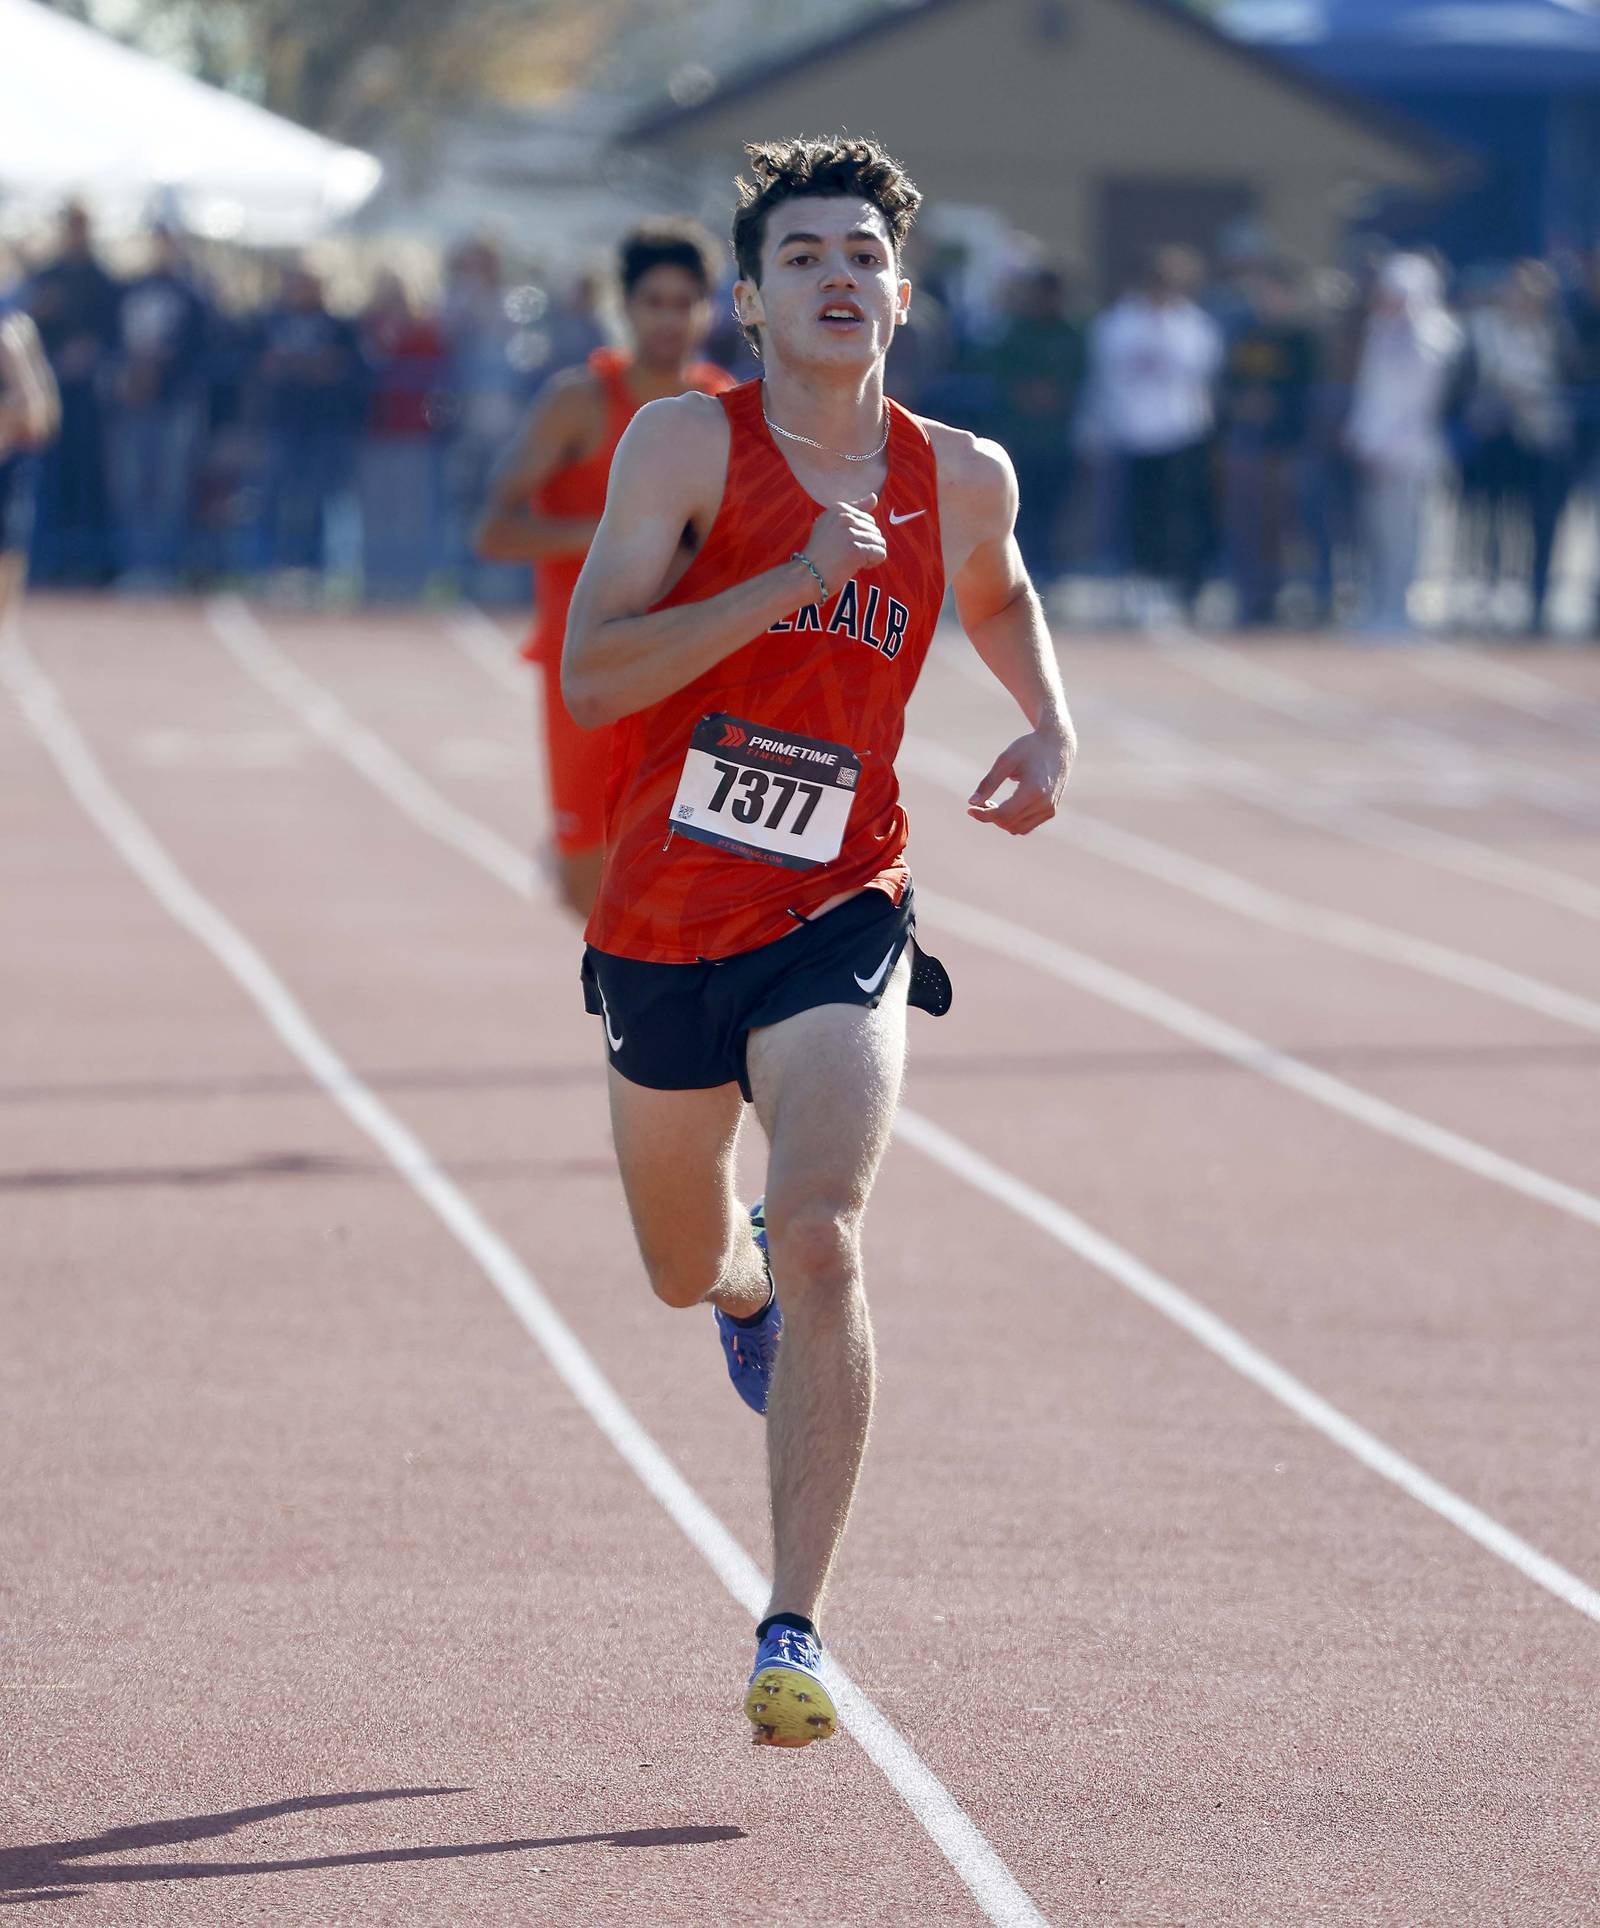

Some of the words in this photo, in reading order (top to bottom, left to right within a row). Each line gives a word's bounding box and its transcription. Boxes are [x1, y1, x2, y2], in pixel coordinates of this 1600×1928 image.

[745, 748, 793, 766] TIMING
[748, 736, 838, 766] PRIMETIME
[707, 760, 823, 836] 7377
